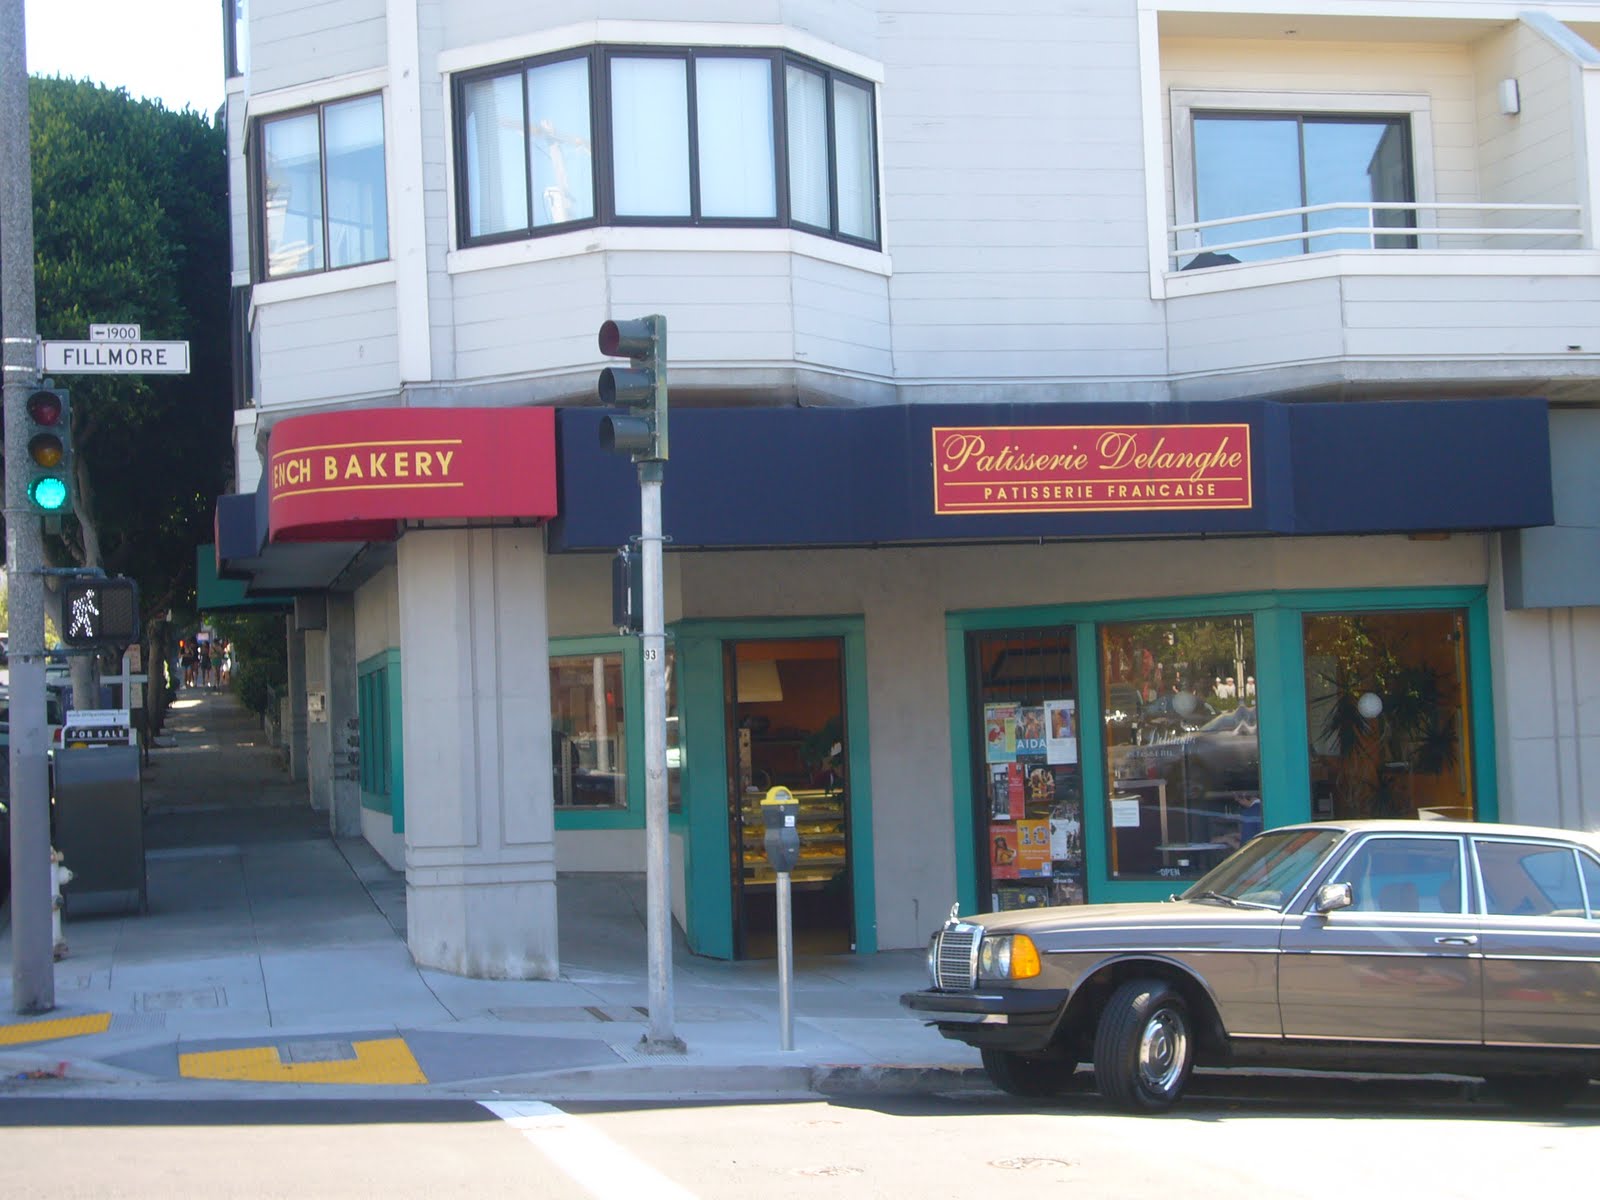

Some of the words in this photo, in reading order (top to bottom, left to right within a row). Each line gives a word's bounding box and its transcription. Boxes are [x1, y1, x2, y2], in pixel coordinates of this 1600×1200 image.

[107, 328, 136, 339] 1900
[63, 348, 168, 366] FILLMORE
[942, 433, 1088, 472] Patisserie
[1095, 431, 1243, 482] Delanghe
[274, 458, 311, 489] ENCH
[324, 451, 454, 481] BAKERY
[984, 485, 1094, 500] PATISSERIE
[1107, 483, 1216, 498] FRANCAISE
[72, 730, 93, 738] FOR
[98, 730, 124, 738] SALE
[1017, 739, 1047, 749] AIDA
[1020, 826, 1048, 846] 10
[1160, 868, 1181, 877] OPEN
